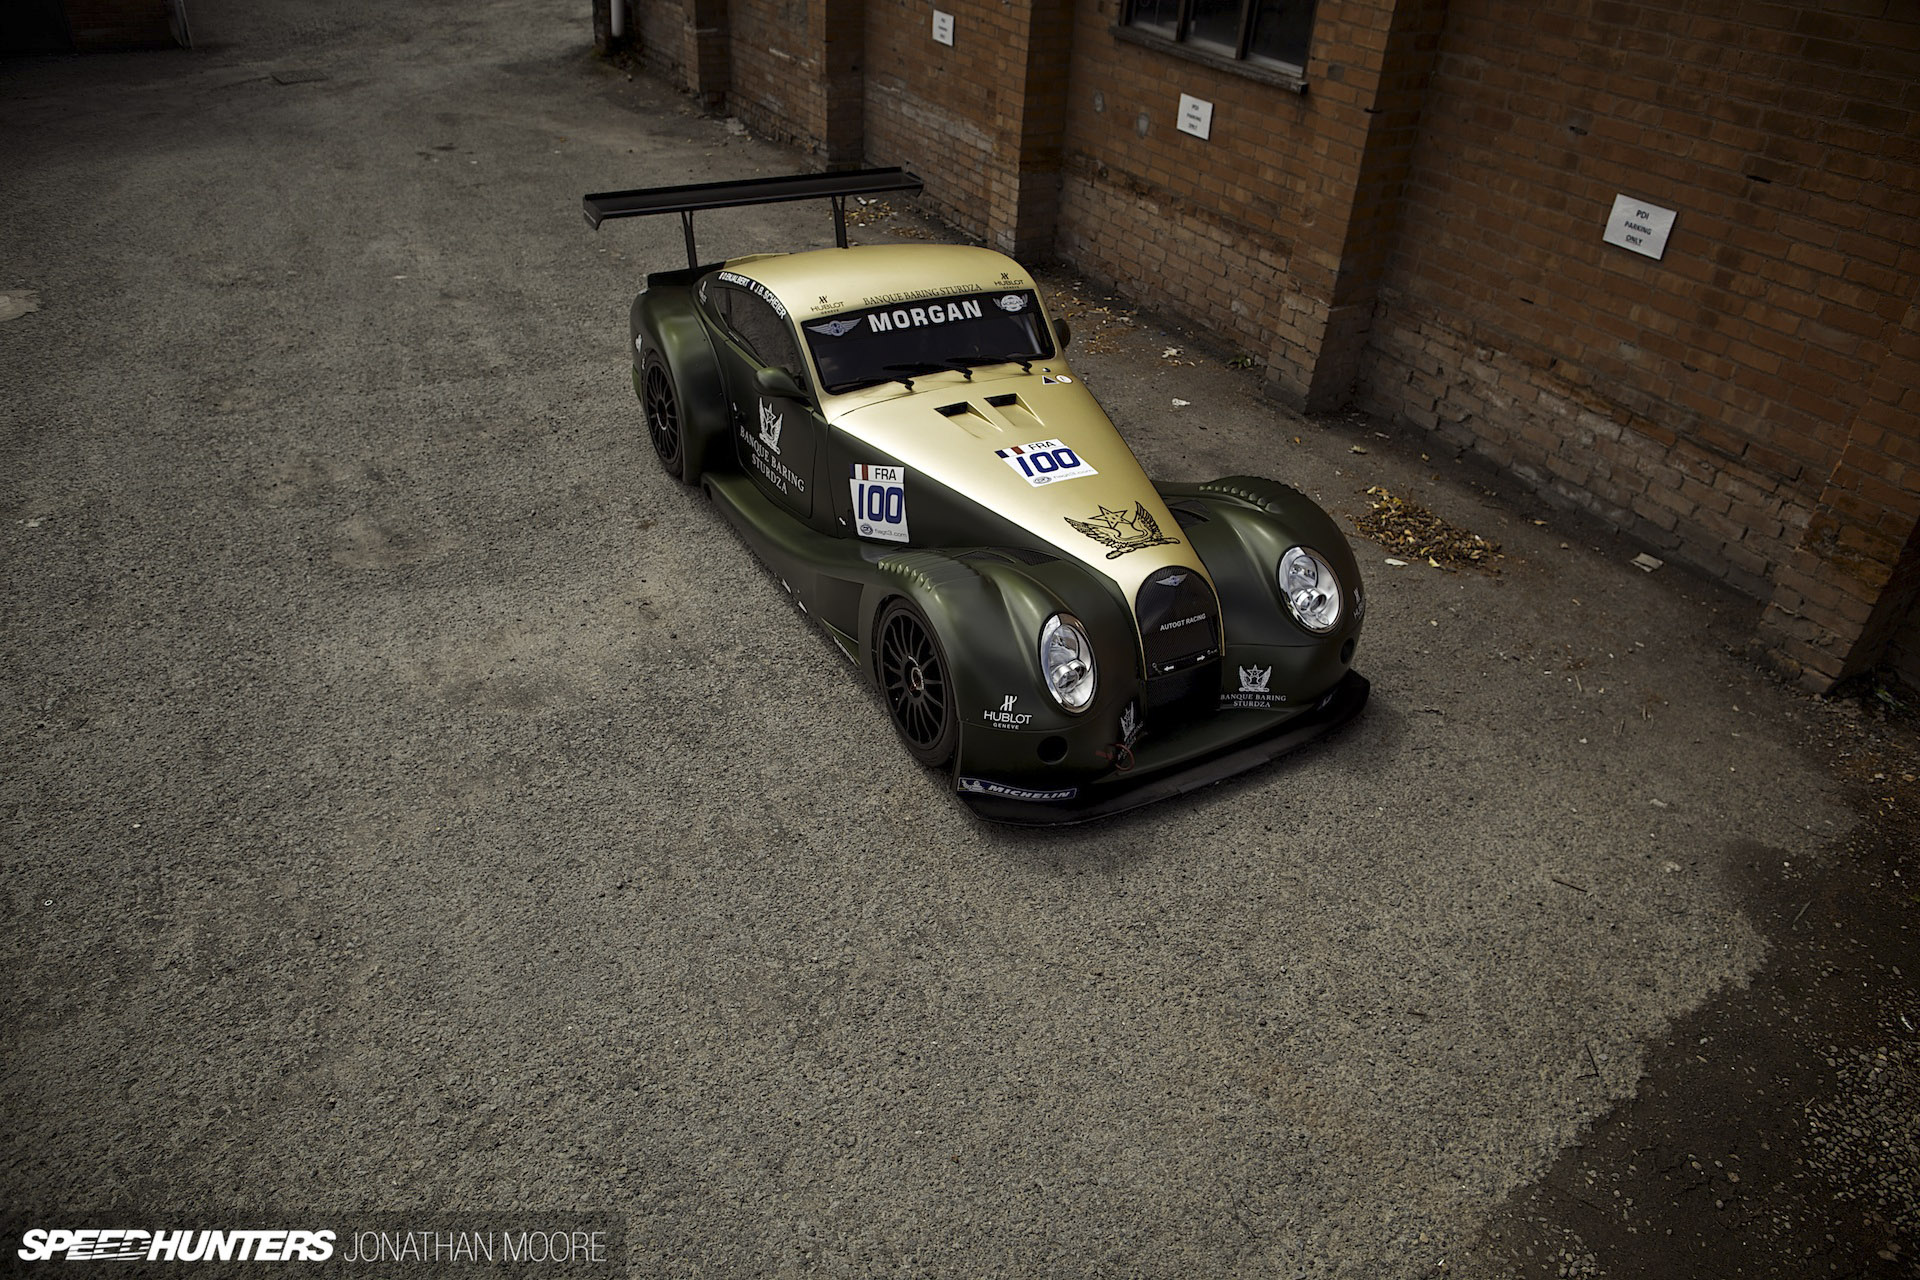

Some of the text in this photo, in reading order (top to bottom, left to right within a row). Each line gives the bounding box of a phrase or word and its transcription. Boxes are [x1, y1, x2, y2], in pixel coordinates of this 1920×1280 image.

[1636, 209, 1649, 220] PDI
[1624, 221, 1652, 235] PARKING
[1625, 234, 1643, 246] ONLY
[994, 279, 1024, 287] HUBLOT
[862, 283, 983, 306] BANQUE BARING STURDZA
[810, 301, 844, 312] HUBLOT
[867, 299, 983, 333] MORGAN
[1028, 441, 1056, 450] FRA
[740, 425, 805, 492] BANQUE BARING
[1016, 448, 1081, 477] 100
[751, 453, 788, 495] STURDZA
[875, 468, 897, 480] FRA
[858, 483, 903, 525] 100
[1160, 613, 1207, 631] AUTOGT RACING
[1255, 694, 1287, 702] BARING
[983, 710, 1032, 725] HUBLOT
[992, 722, 1020, 730] GENEVE
[988, 785, 1071, 799] MICHELIN
